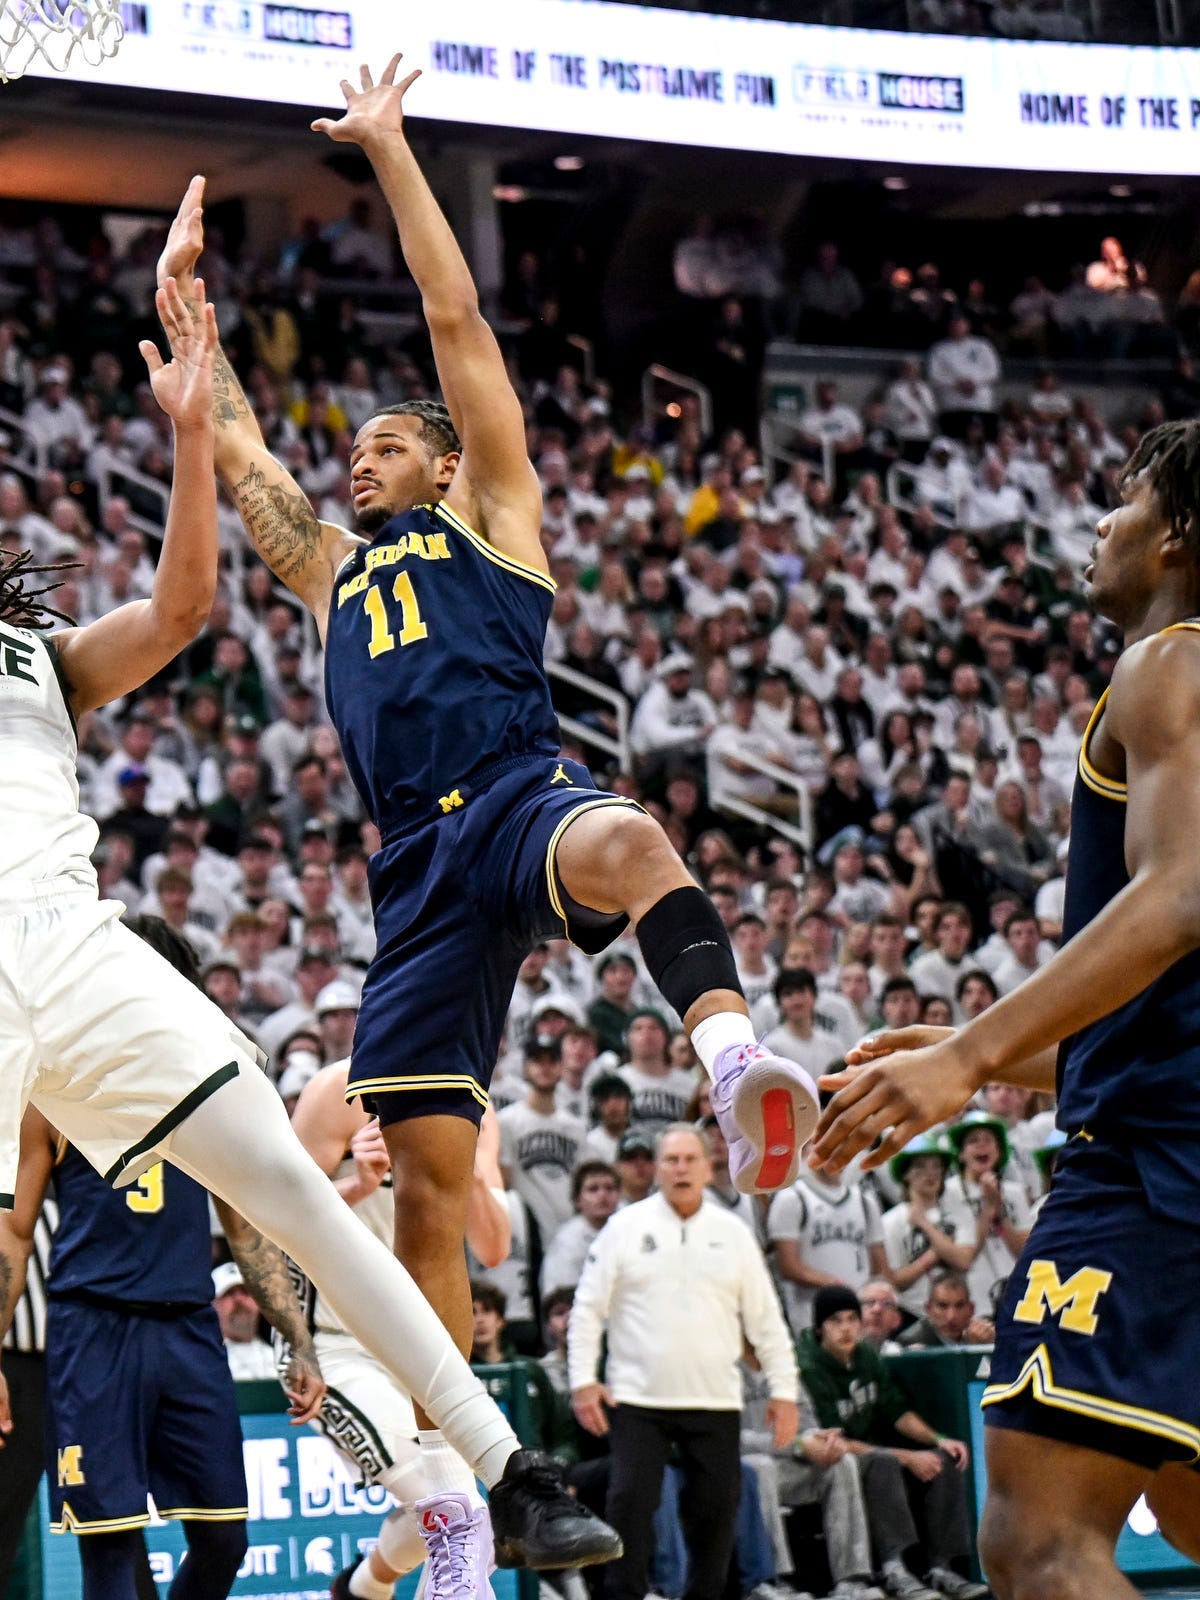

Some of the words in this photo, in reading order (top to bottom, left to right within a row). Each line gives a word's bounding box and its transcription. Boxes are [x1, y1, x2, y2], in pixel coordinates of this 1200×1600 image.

[431, 41, 499, 79] HOME
[513, 49, 536, 81] OF
[550, 54, 587, 88] THE
[599, 58, 724, 103] POSTGAME
[735, 75, 776, 107] FUN
[880, 74, 963, 111] HOUSE
[1019, 93, 1090, 126] HOME
[1101, 96, 1125, 126] OF
[1137, 98, 1180, 130] THE
[338, 531, 451, 611] MIHIGAN
[363, 570, 428, 660] 11
[438, 789, 464, 814] M
[126, 1160, 165, 1214] 3
[1013, 1259, 1113, 1337] M
[57, 1444, 87, 1487] M
